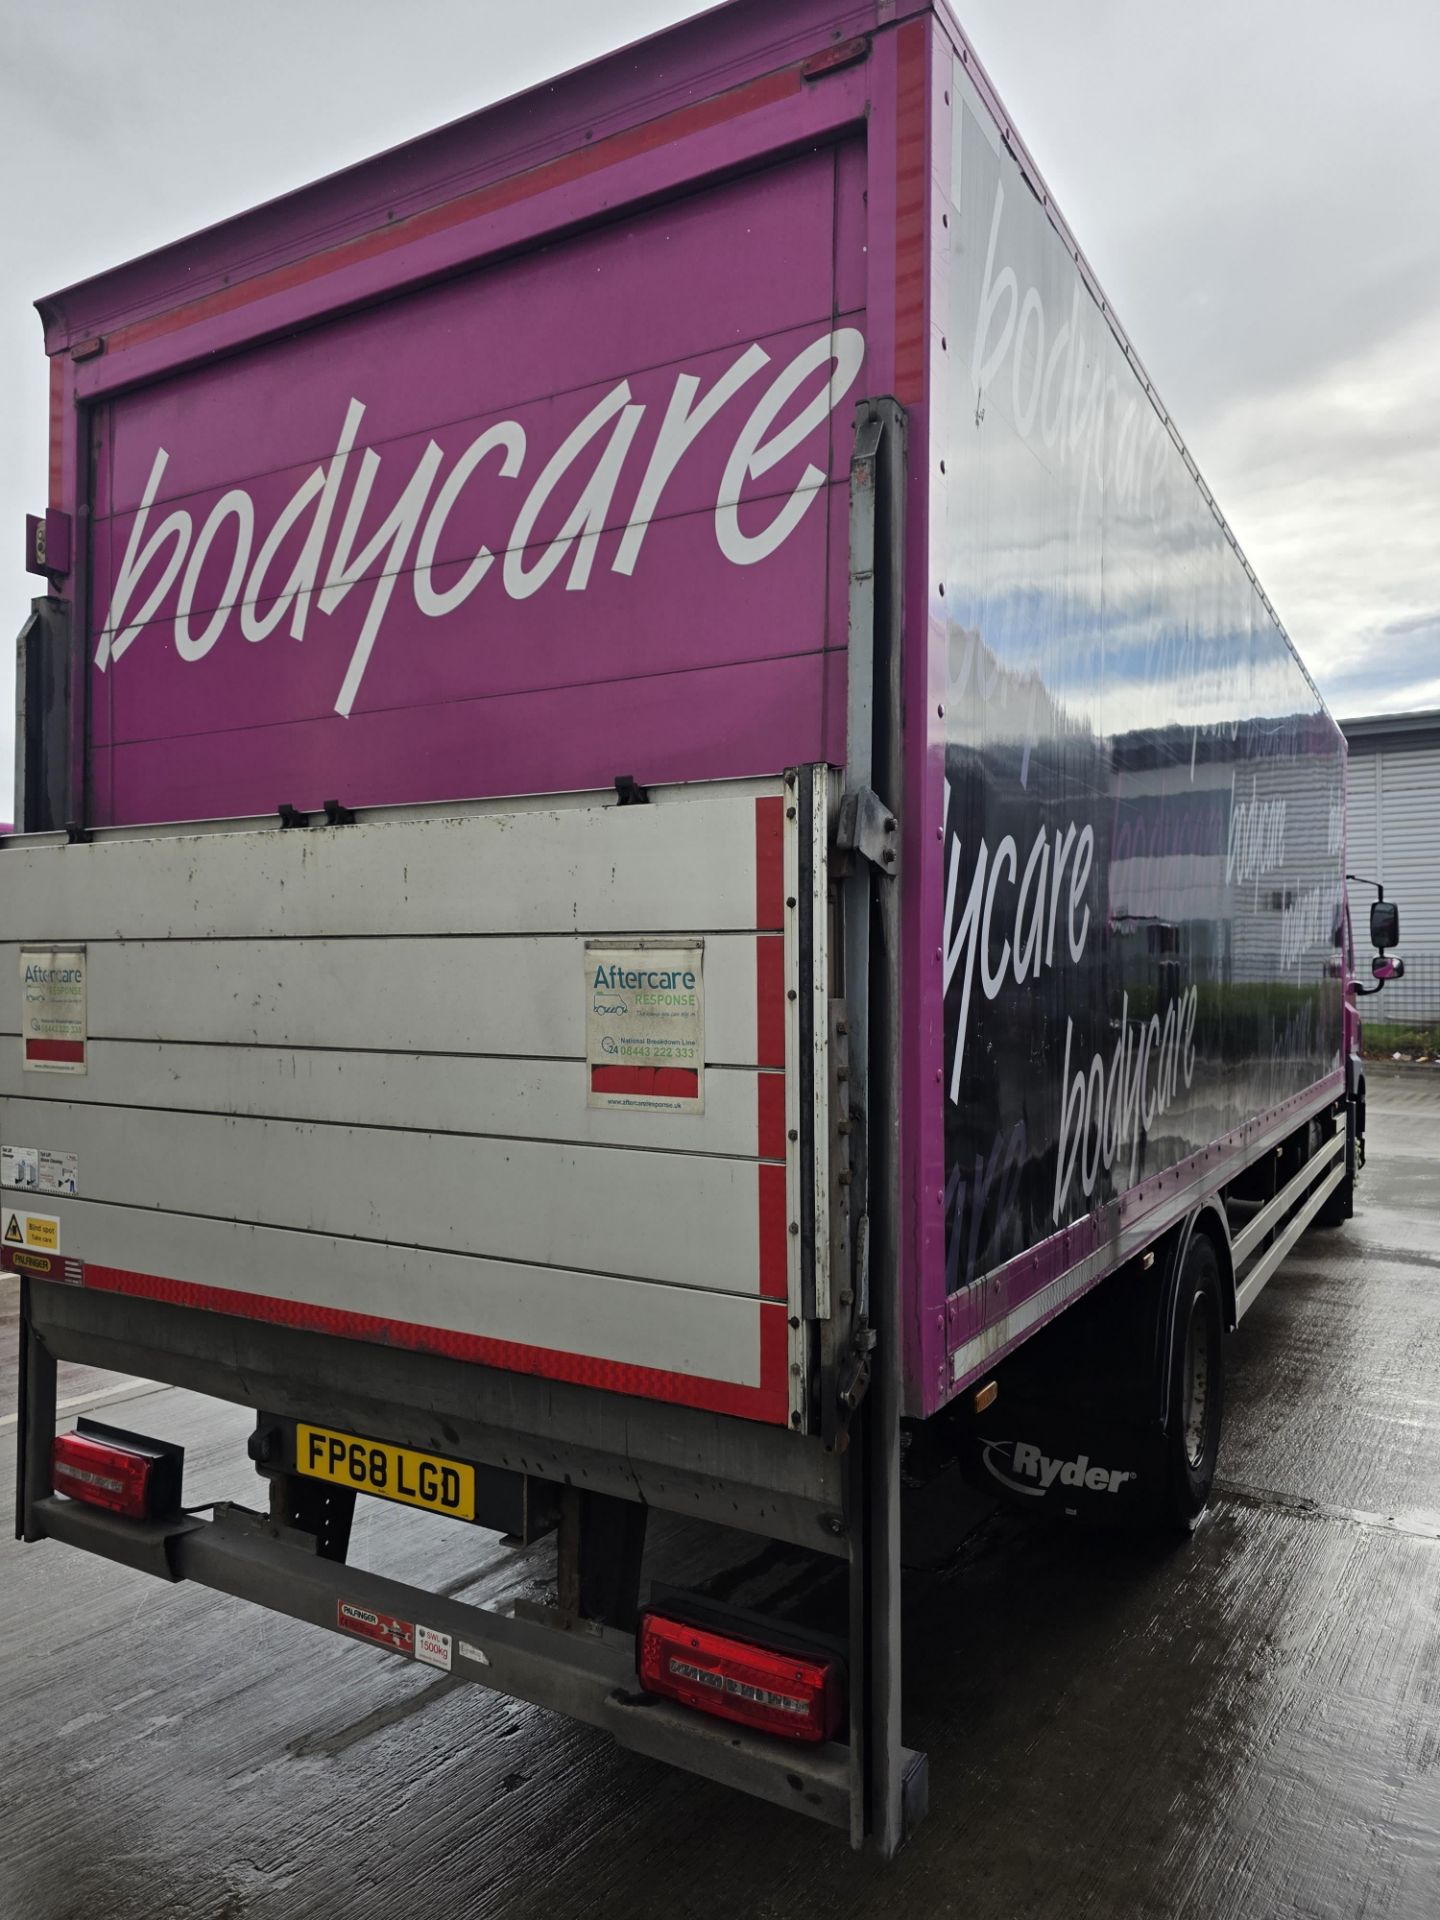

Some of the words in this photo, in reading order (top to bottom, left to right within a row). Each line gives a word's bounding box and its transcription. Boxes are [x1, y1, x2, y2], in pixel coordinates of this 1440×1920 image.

[94, 327, 865, 719] bodycare
[943, 776, 1095, 1106] ycare
[25, 965, 82, 983] Aftercare
[593, 964, 696, 990] Aftercare
[635, 994, 696, 1006] RESPONSE
[620, 1037, 645, 1045] National
[620, 1046, 651, 1057] 08443
[653, 1047, 673, 1058] 222
[675, 1048, 695, 1059] 333
[1053, 985, 1198, 1227] bodycare
[309, 1432, 387, 1488] FP68
[397, 1455, 460, 1509] LGD
[1012, 1441, 1130, 1494] Ryder
[343, 1605, 377, 1624] PALFINGER
[426, 1631, 441, 1643] SWL
[420, 1639, 449, 1661] 1500kg
